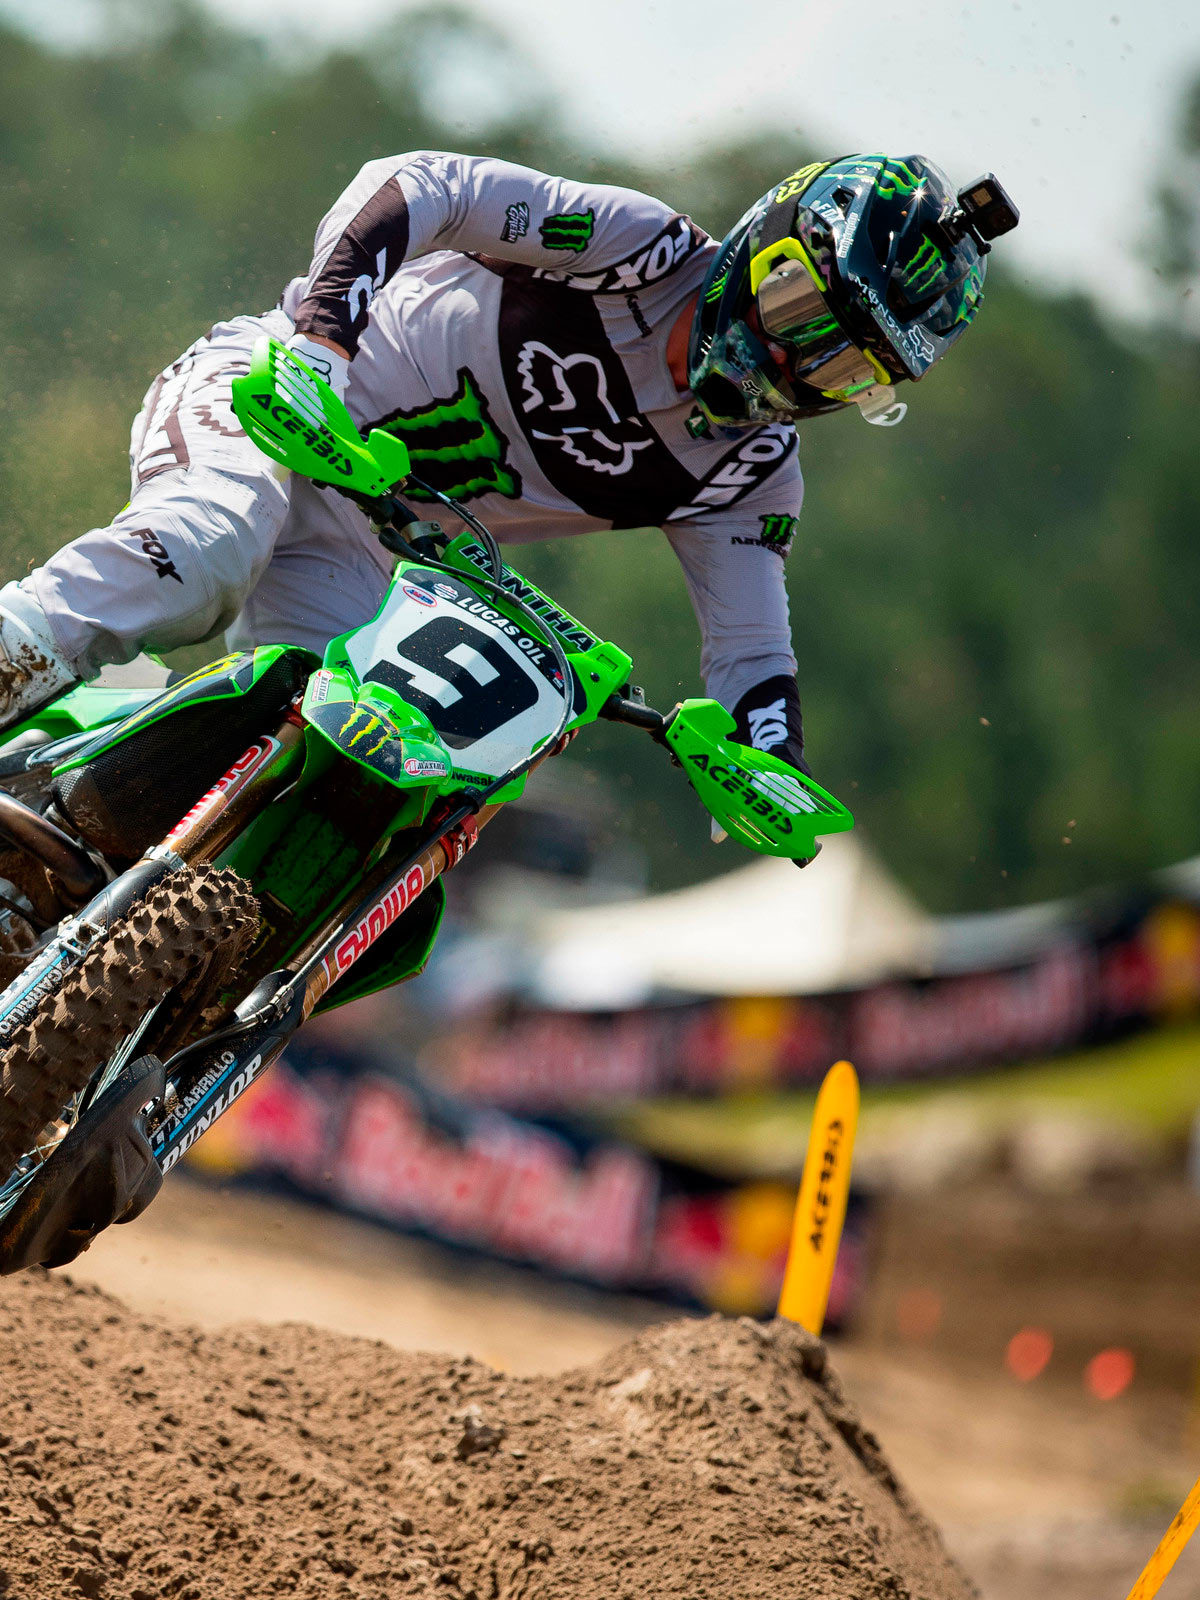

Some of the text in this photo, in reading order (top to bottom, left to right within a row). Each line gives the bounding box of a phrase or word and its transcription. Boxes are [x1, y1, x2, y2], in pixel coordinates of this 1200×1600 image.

[606, 217, 692, 291] FOX
[853, 276, 917, 367] MONSTER
[709, 420, 797, 485] FOX
[129, 527, 185, 586] FOX
[456, 595, 521, 637] LUCAS
[517, 635, 547, 666] OIL
[458, 543, 597, 653] RENTHA
[362, 615, 540, 751] 9
[747, 697, 789, 752] OX
[334, 863, 426, 975] SHOWA
[161, 1053, 262, 1177] DUNLOP
[174, 1050, 235, 1119] CARRILLO
